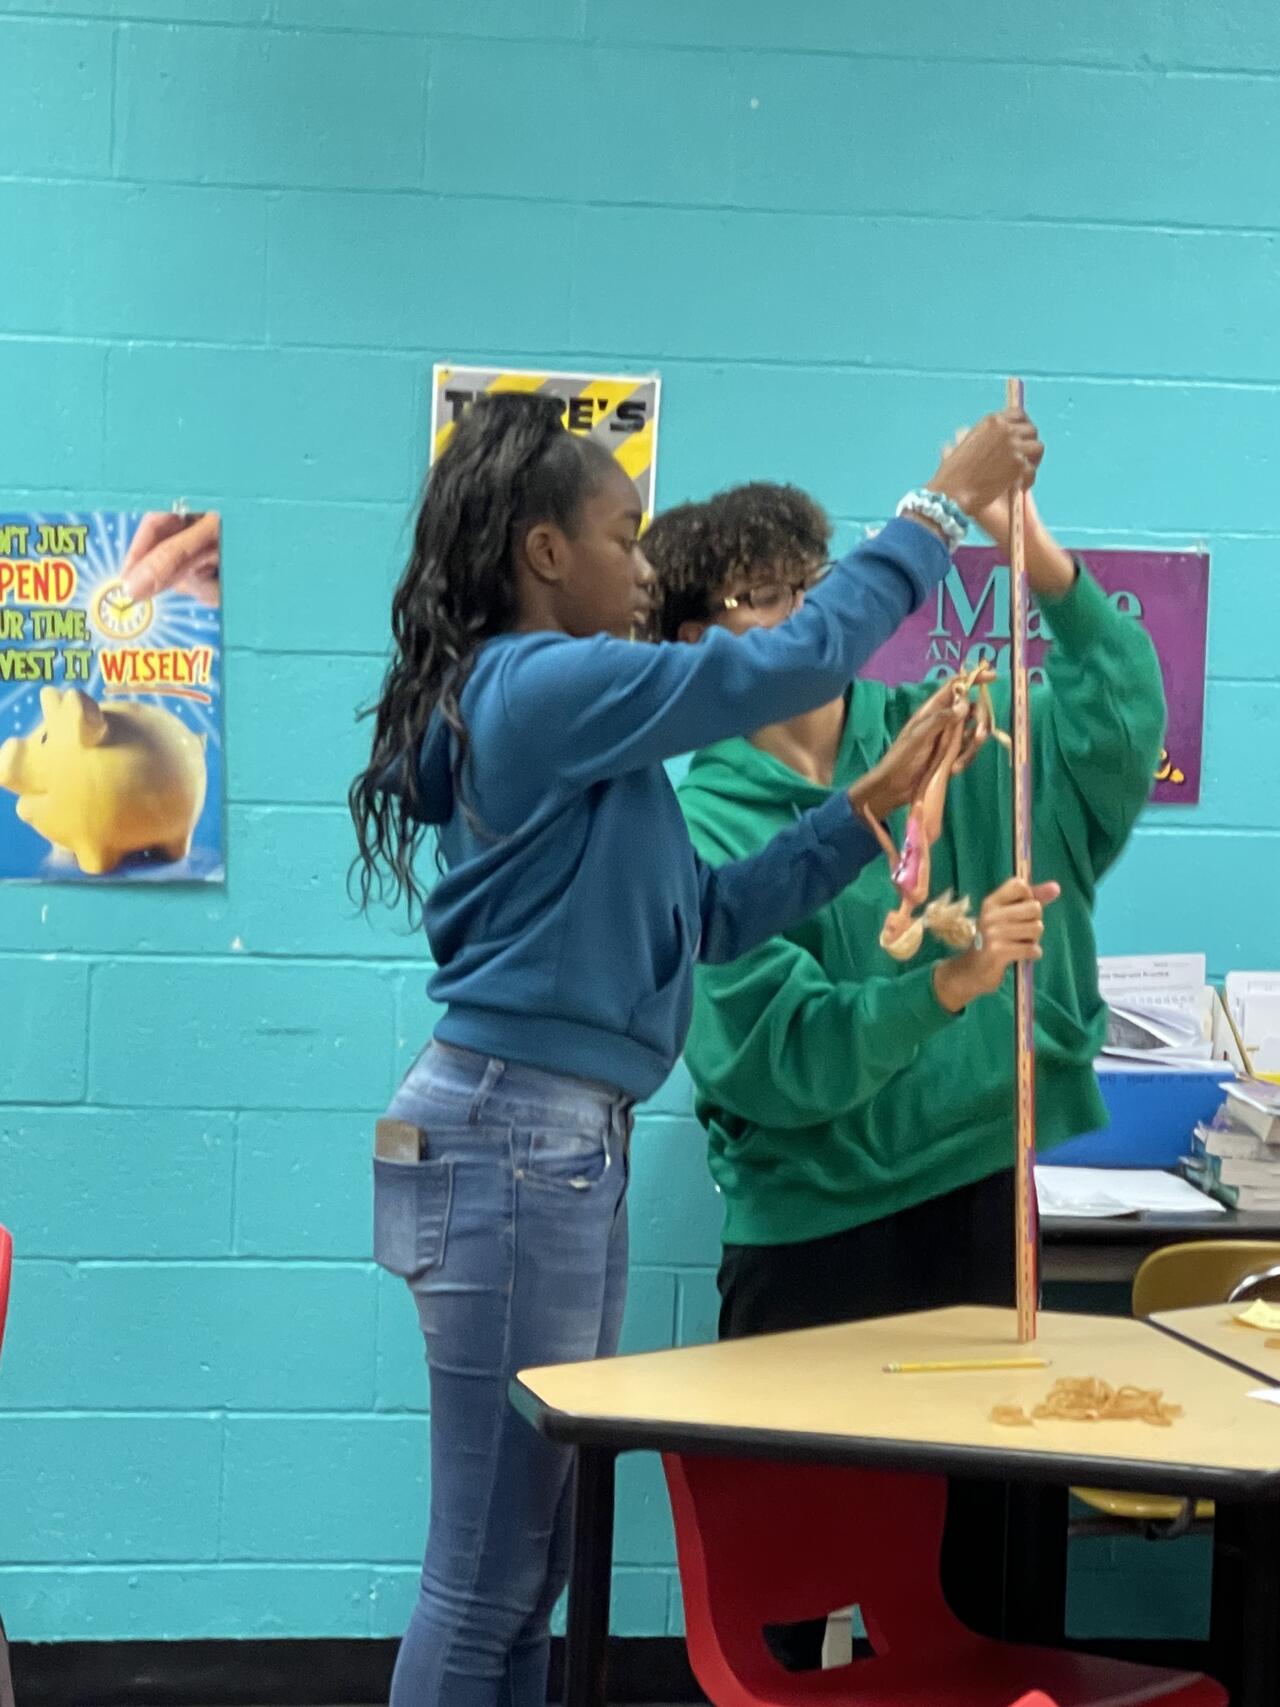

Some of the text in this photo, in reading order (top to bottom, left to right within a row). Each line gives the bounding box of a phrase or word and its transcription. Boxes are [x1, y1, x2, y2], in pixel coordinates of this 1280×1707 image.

[35, 525, 88, 556] JUST
[0, 561, 74, 603] PEND
[928, 564, 1142, 640] Mae
[0, 649, 209, 683] VEST IT WISELY!
[925, 639, 961, 661] AN
